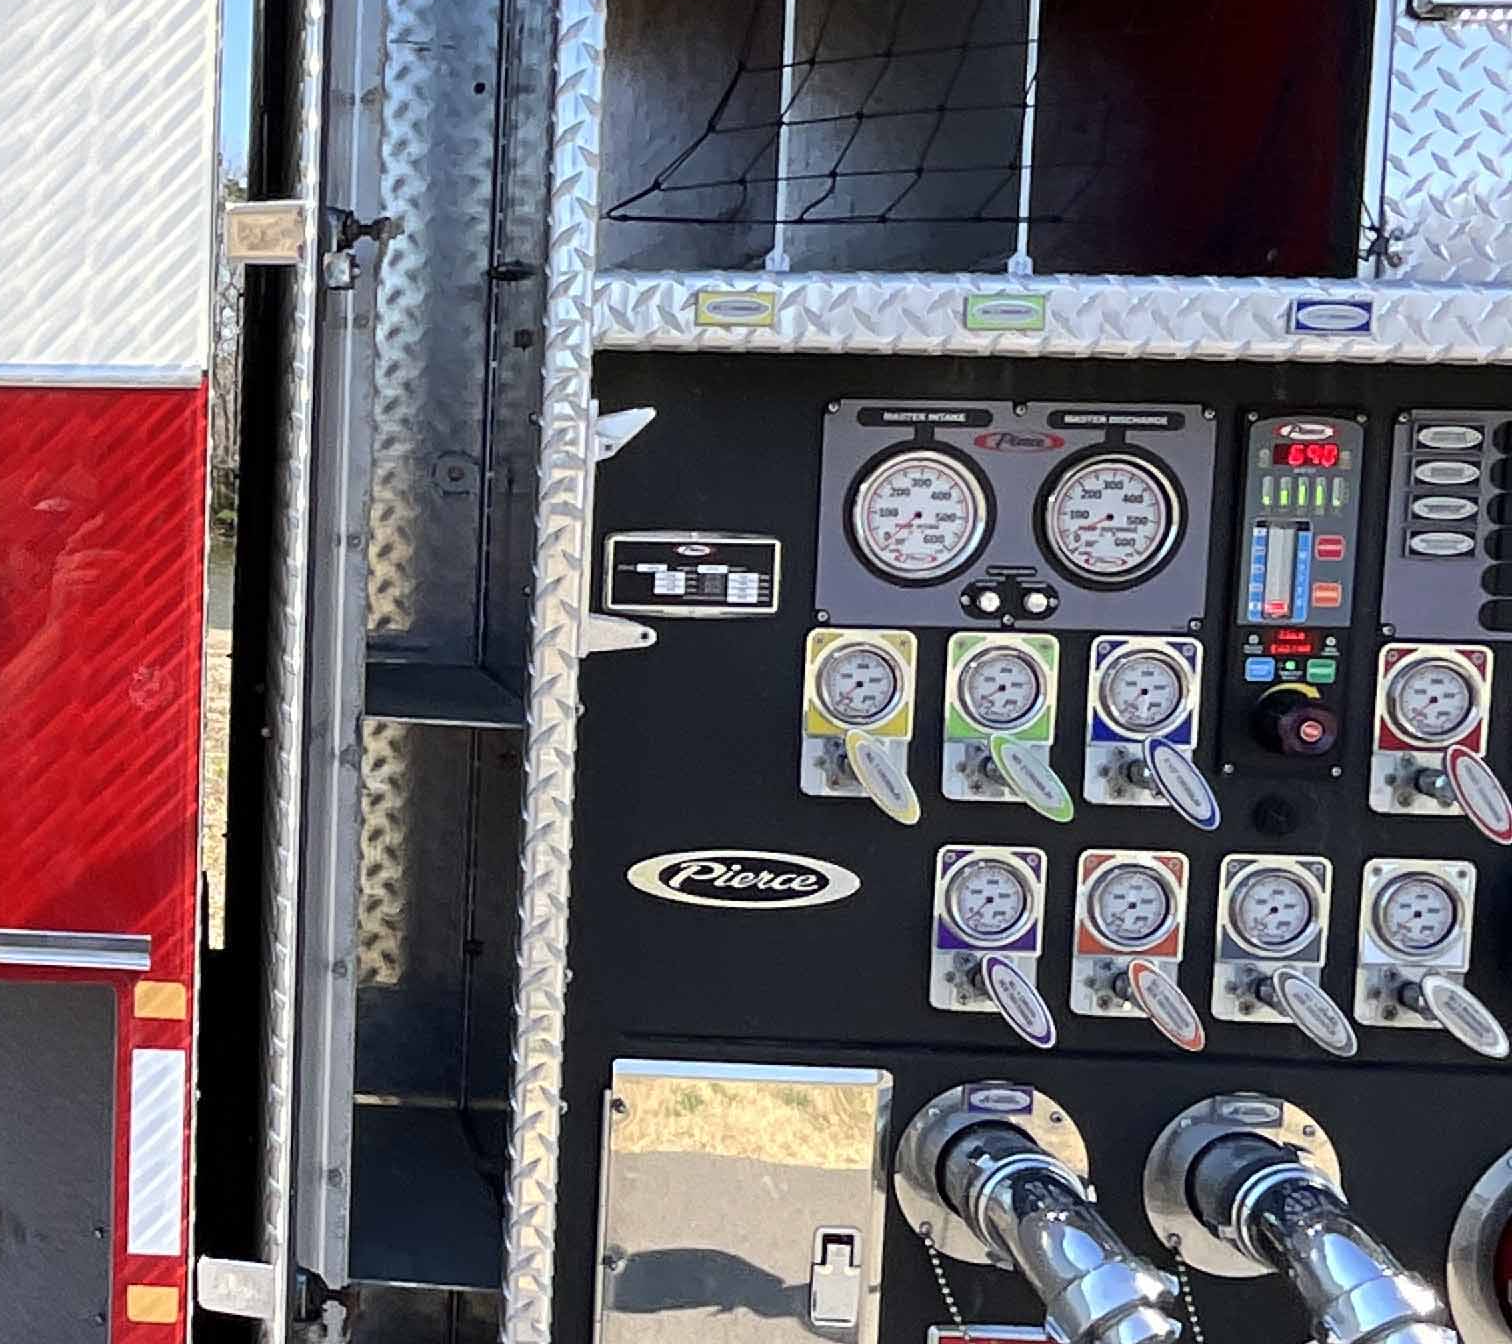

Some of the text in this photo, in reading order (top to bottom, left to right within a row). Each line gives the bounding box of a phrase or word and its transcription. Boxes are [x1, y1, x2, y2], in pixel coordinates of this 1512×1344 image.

[883, 411, 967, 423] MASTER INTAKE
[1064, 414, 1168, 425] MASTER DISCHARGE
[911, 478, 932, 488] 300
[1103, 480, 1124, 490] 300
[889, 488, 911, 497] 200
[931, 491, 951, 501] 400
[1080, 489, 1102, 499] 200
[1122, 493, 1143, 504] 400
[879, 507, 899, 517] 100
[1070, 510, 1090, 520] 100
[935, 513, 956, 522] 500
[1126, 516, 1148, 525] 500
[923, 534, 945, 544] 600
[1114, 537, 1136, 547] 600
[668, 861, 819, 891] Pierce
